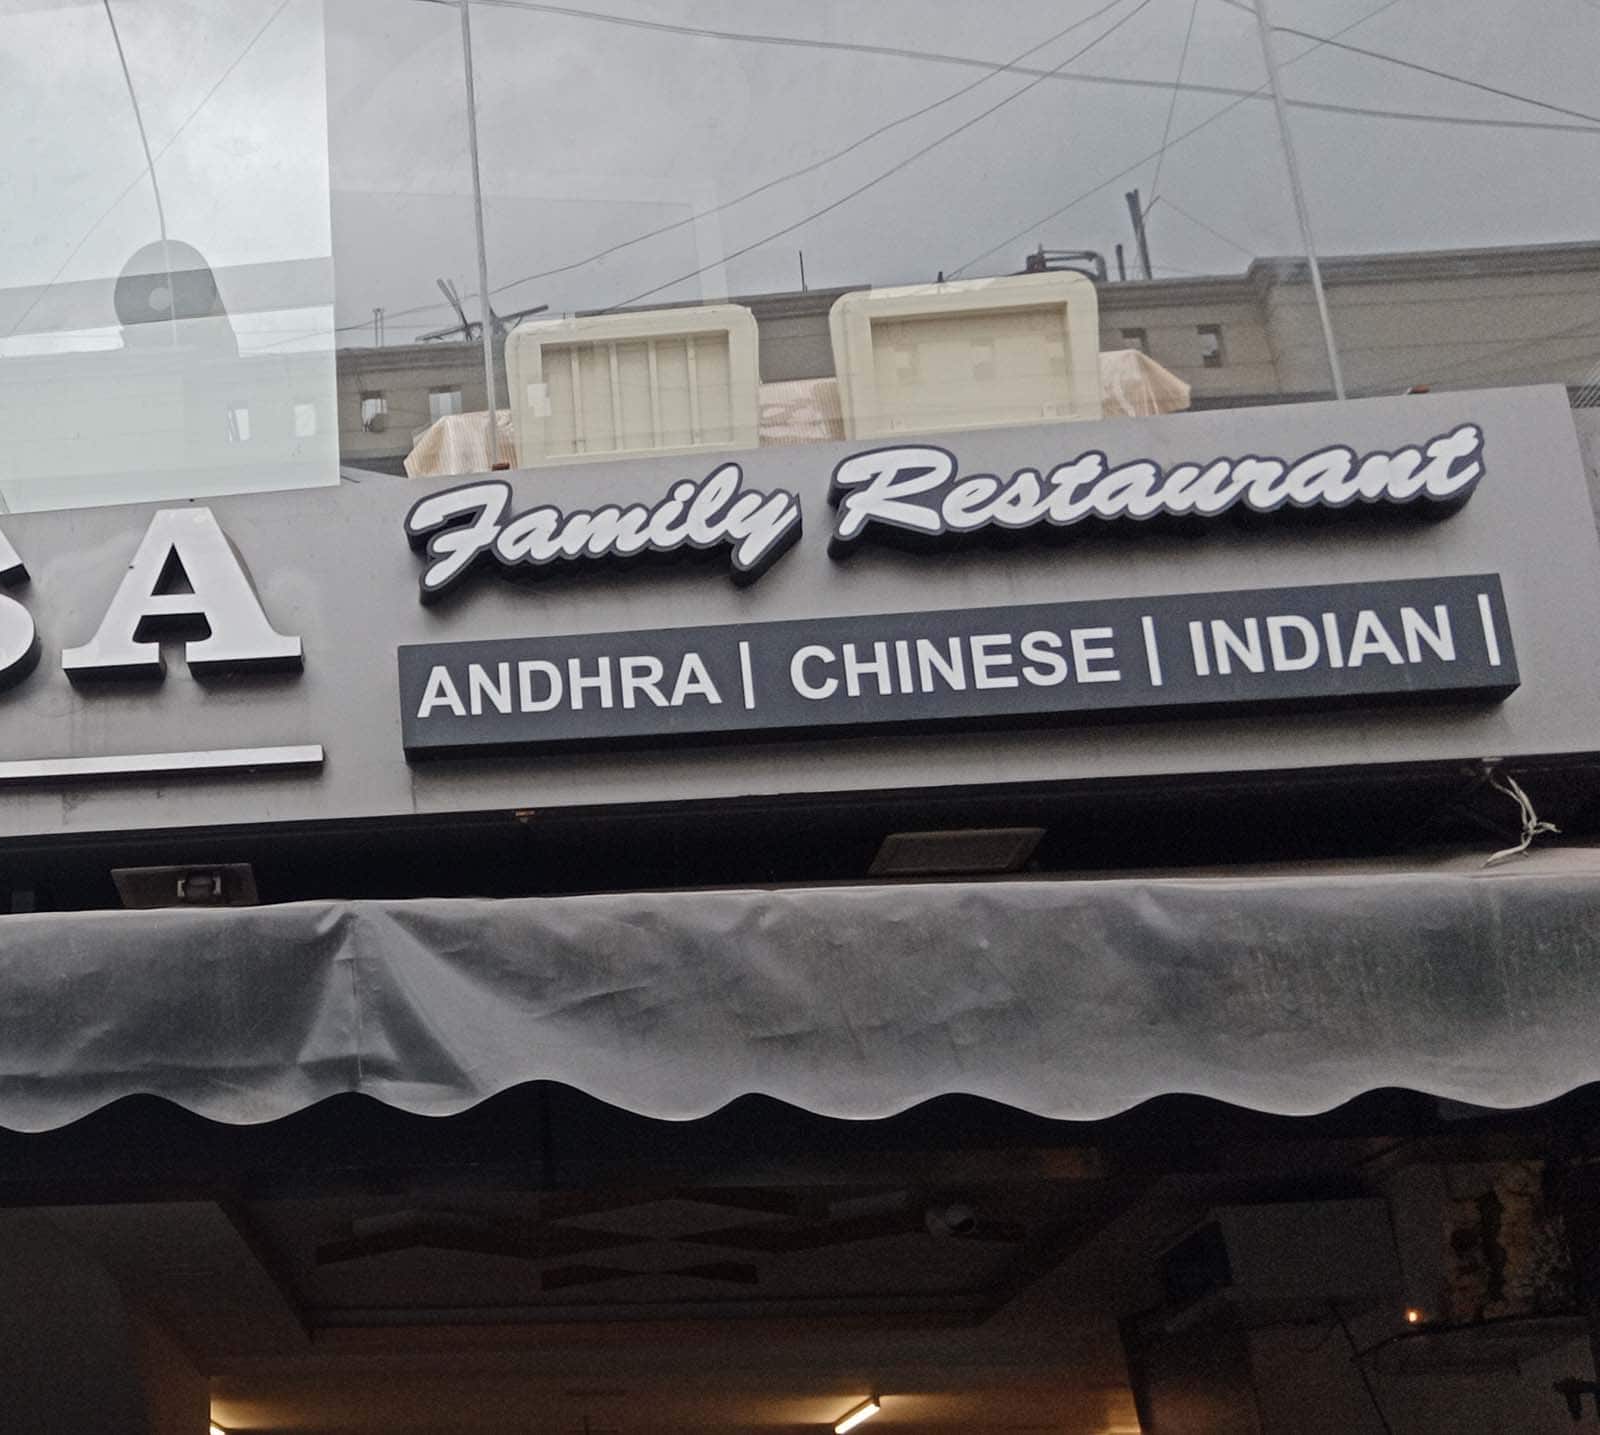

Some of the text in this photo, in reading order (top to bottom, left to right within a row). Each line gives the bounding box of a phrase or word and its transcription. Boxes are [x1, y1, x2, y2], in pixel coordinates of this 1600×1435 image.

[407, 423, 1484, 589] Family Restaurant
[416, 651, 723, 719] ANDHRA
[789, 626, 1122, 701] CHINESE
[1188, 604, 1457, 677] INDIAN
